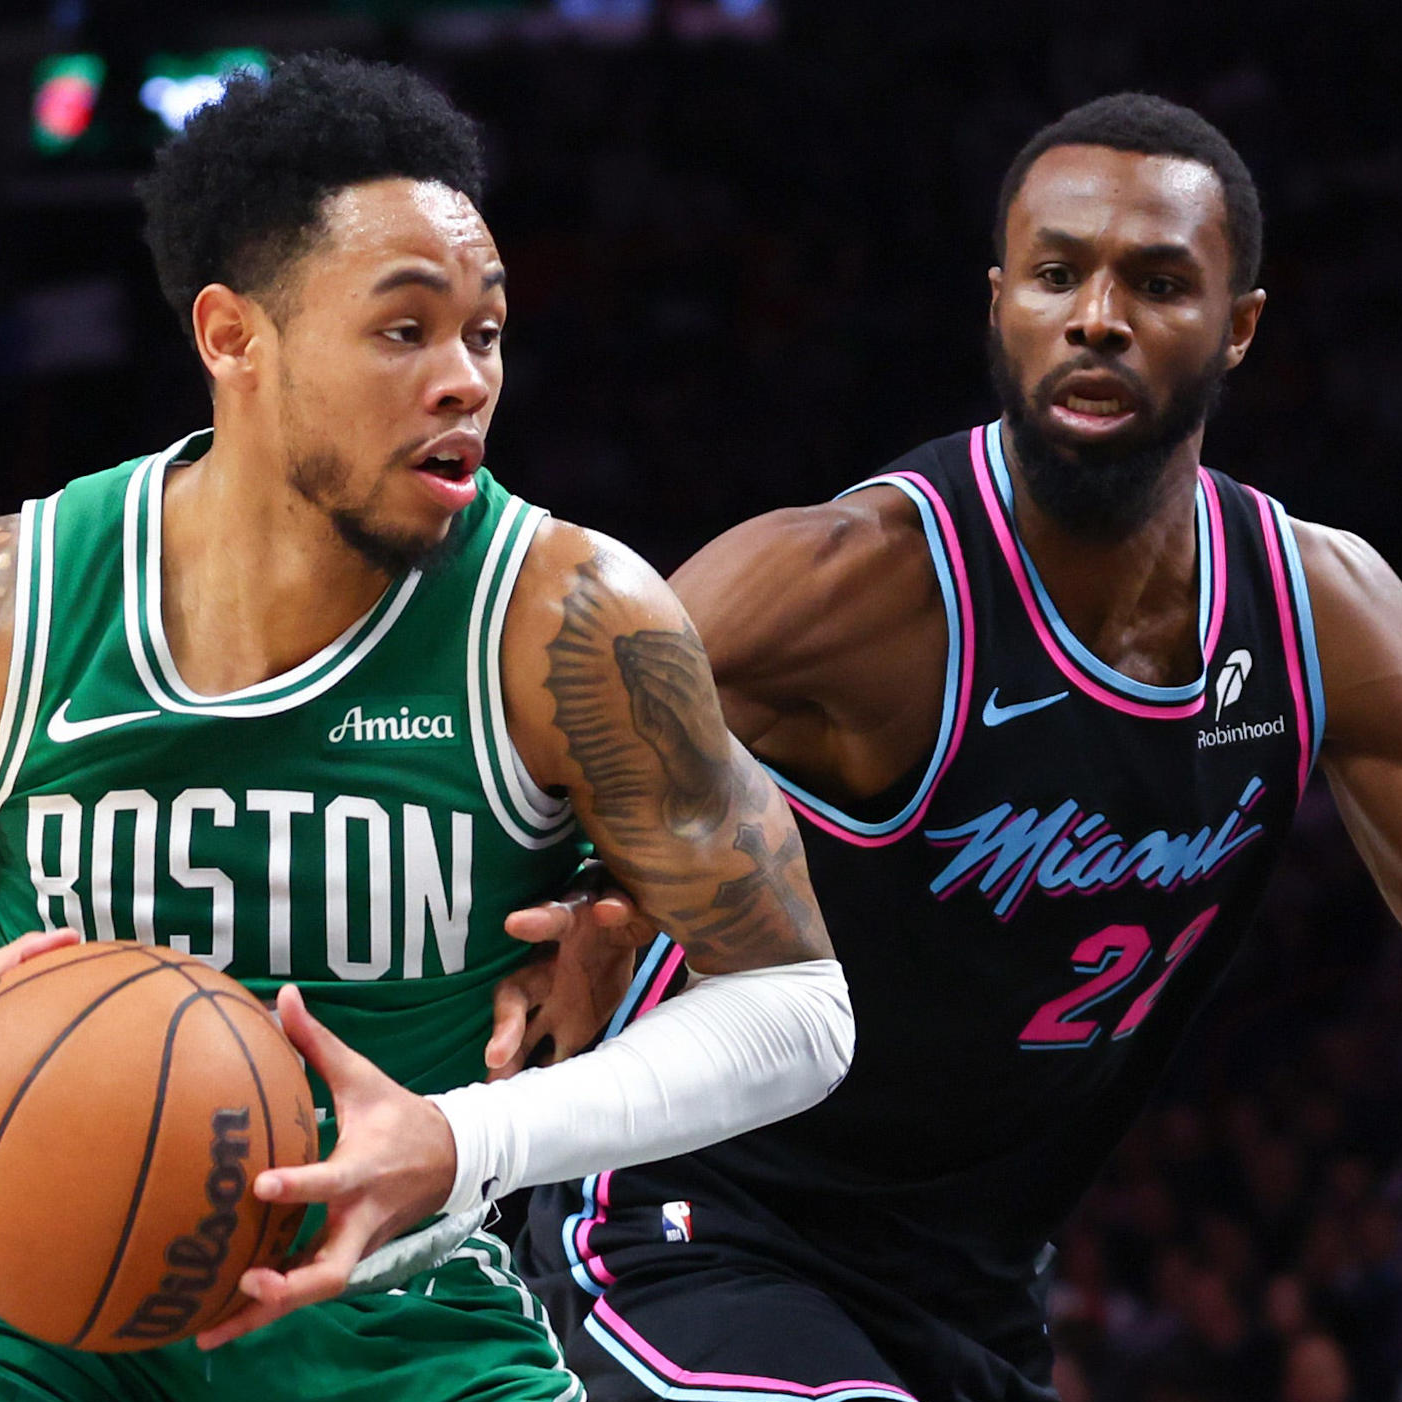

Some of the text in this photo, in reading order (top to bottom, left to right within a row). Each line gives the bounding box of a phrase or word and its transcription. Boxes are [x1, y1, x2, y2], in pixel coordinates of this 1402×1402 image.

[328, 705, 455, 744] Amica
[1197, 715, 1285, 749] Robinhood
[26, 787, 474, 982] BOSTON
[924, 776, 1267, 923] Miami
[114, 1106, 250, 1340] Wilson
